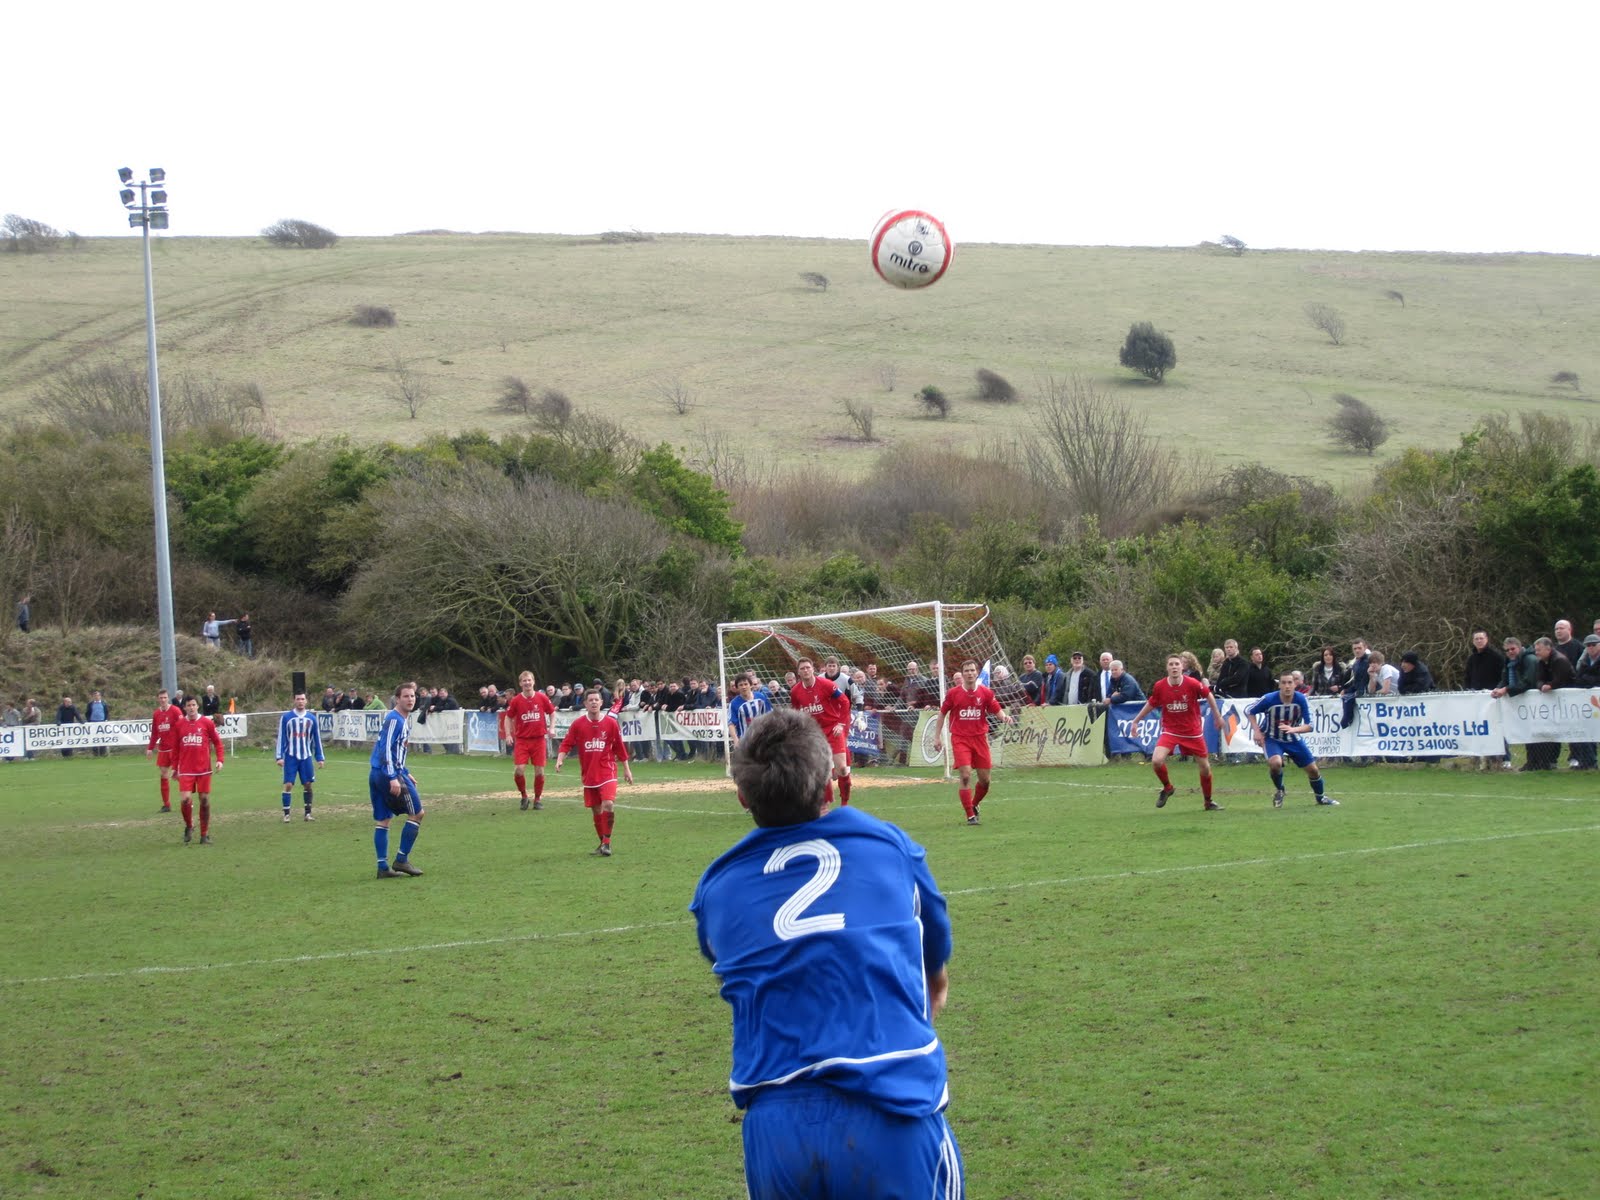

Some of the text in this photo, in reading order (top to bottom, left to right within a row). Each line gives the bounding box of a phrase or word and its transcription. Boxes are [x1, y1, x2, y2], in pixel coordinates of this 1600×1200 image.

[889, 251, 929, 274] mitre
[959, 709, 981, 717] GMB
[1166, 702, 1188, 711] GMB
[1375, 702, 1426, 719] Bryant
[1517, 696, 1592, 721] overline
[521, 712, 541, 721] GMB
[676, 711, 721, 726] CHANNEL
[29, 725, 91, 738] BRIGHTON
[1377, 719, 1489, 737] Decorators Ltd
[31, 736, 119, 747] 0845 873 8126
[182, 735, 203, 744] GMB
[1053, 716, 1091, 757] People
[584, 740, 606, 749] GMB
[1377, 739, 1459, 751] 01273 541005
[763, 838, 847, 941] 2
